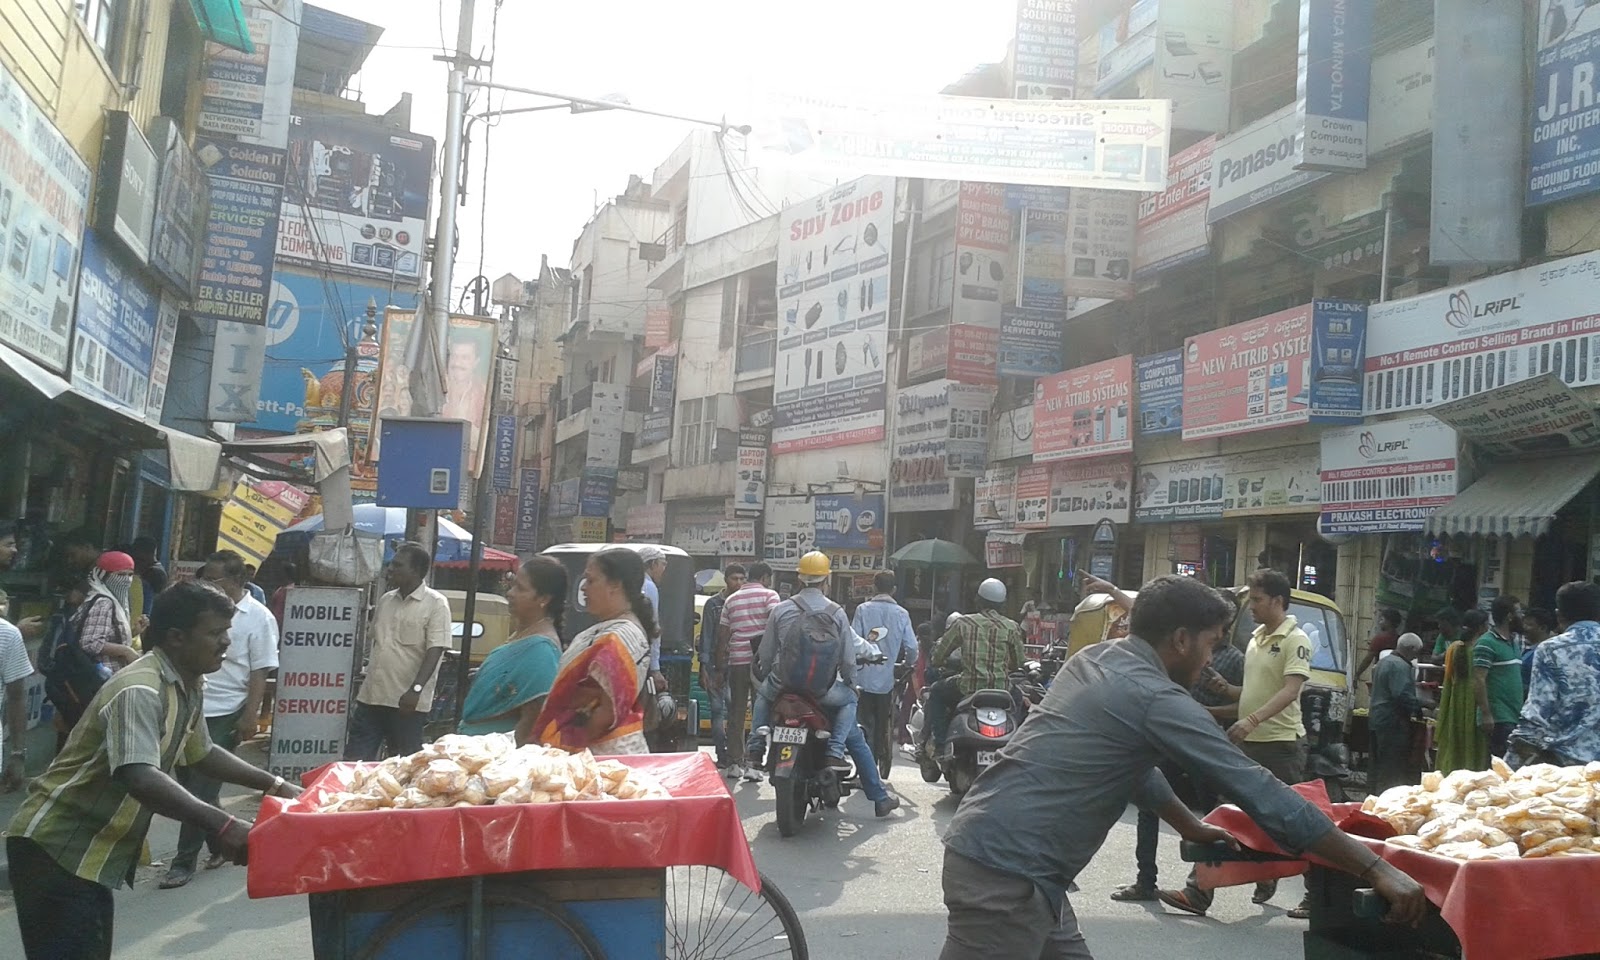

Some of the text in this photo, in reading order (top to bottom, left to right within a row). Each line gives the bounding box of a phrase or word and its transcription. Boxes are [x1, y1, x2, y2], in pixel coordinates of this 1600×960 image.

[1330, 43, 1344, 112] MINOLTA
[1556, 135, 1582, 156] INC.
[228, 146, 284, 166] Golden IT
[230, 164, 277, 182] Solution
[1531, 168, 1570, 190] GROUND
[830, 190, 883, 226] Zone
[790, 212, 826, 241] Spy
[214, 288, 222, 300] &
[226, 289, 264, 306] SELLER
[1316, 302, 1362, 312] TP-LINK
[1002, 324, 1036, 335] SERVICE
[1010, 320, 1055, 330] COMPUTER
[1380, 352, 1400, 366] No.1
[1402, 347, 1439, 362] Remote
[1442, 340, 1478, 355] Control
[1481, 332, 1518, 348] Selling
[1521, 325, 1554, 341] Brand
[1556, 322, 1568, 333] in
[1201, 357, 1227, 378] NEW
[1230, 346, 1268, 370] ATTRIB
[1144, 364, 1176, 380] COMPUTER
[1140, 374, 1182, 392] SERVICE POINT
[1046, 381, 1128, 412] NEW ATTRIB SYSTEMS
[256, 400, 307, 417] ett-Pa
[1490, 392, 1572, 420] Technologies
[1528, 410, 1592, 434] REFILLING
[500, 430, 512, 469] LAPTOP
[740, 450, 765, 458] LAPTOP
[740, 458, 764, 466] REPAIR
[522, 486, 535, 530] LAPTOP
[1330, 510, 1373, 522] PRAKASH
[291, 604, 352, 620] MOBILE
[284, 632, 354, 648] SERVICE
[284, 672, 345, 688] MOBILE
[278, 698, 346, 714] SERVICE
[278, 740, 339, 754] MOBILE
